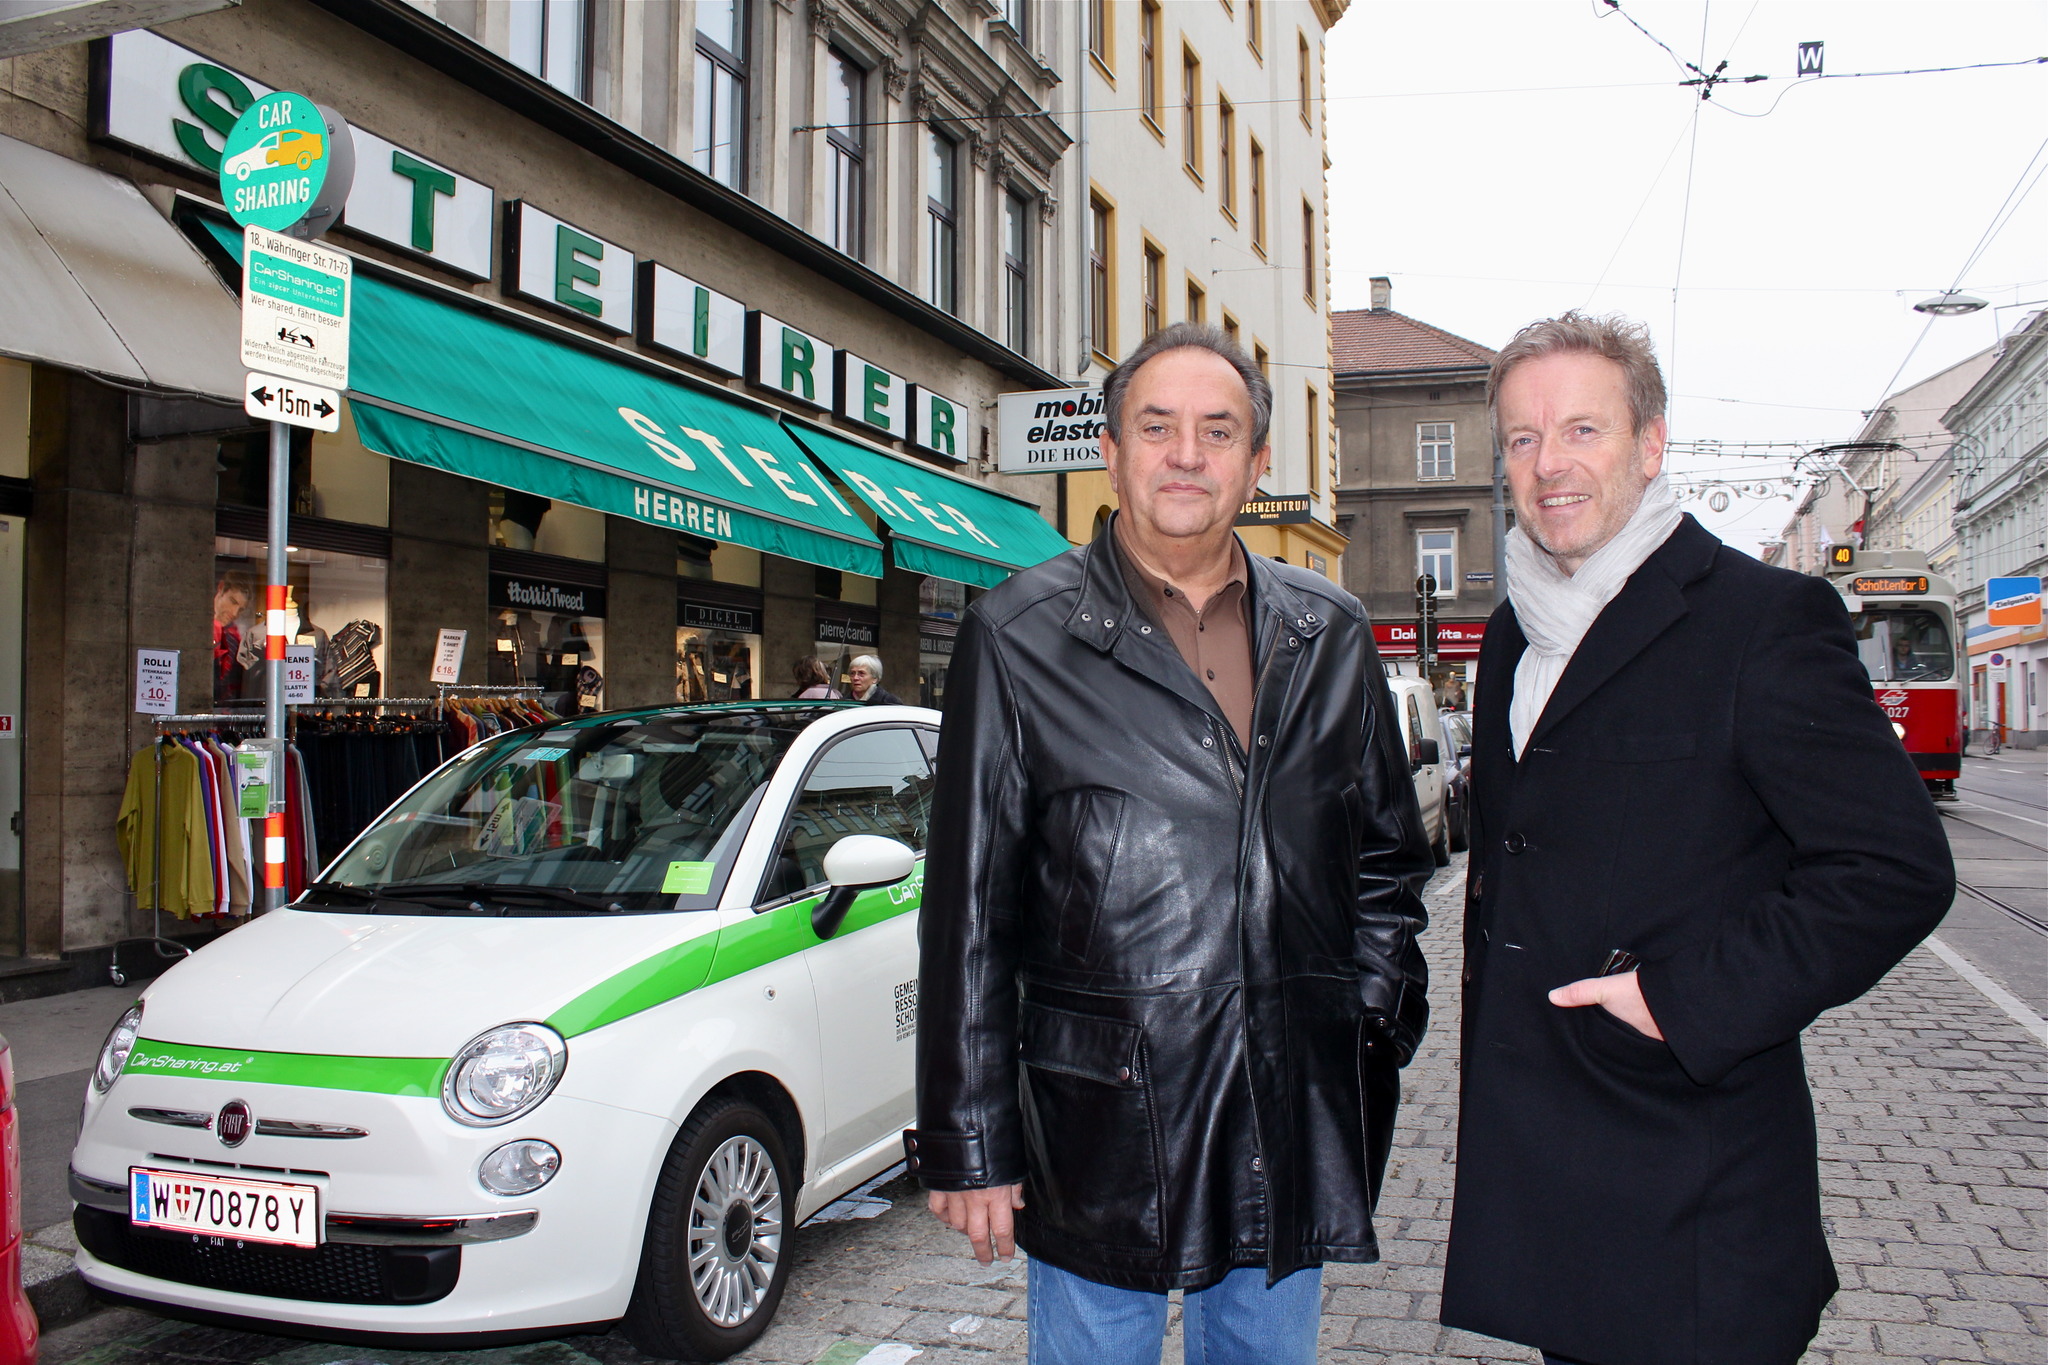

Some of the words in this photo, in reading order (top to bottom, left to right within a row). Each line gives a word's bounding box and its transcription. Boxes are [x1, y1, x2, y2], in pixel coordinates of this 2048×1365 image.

[1800, 46, 1823, 70] W
[258, 100, 292, 130] CAR
[234, 177, 310, 213] SHARING
[173, 62, 956, 456] STEIRER
[266, 237, 311, 262] Währinger
[313, 253, 327, 269] Str.
[328, 258, 349, 275] 71-73
[254, 277, 266, 286] Ein
[268, 281, 290, 293] zipcar
[292, 289, 338, 308] Unternehmen
[250, 294, 265, 306] Wer
[268, 299, 296, 316] shared,
[297, 307, 316, 322] fährt
[318, 314, 341, 329] besser
[244, 338, 286, 356] Widerrechtlich
[287, 349, 318, 365] abgestellte
[318, 357, 346, 372] Fahrzeuge
[244, 349, 267, 360] werden
[267, 354, 309, 372] kostenpflichtig
[310, 366, 345, 380] abgeschleppt
[276, 386, 310, 418] 15m
[1034, 392, 1106, 419] mobi
[1027, 448, 1058, 463] DIE
[1063, 446, 1103, 461] HOS
[618, 407, 1000, 548] STEIRER
[634, 486, 733, 538] HERREN
[1836, 548, 1850, 562] 40
[1856, 578, 1917, 592] Schottentor
[1995, 595, 2033, 609] Zielpunkt
[699, 608, 740, 624] DIGEL
[819, 620, 845, 639] pierre
[847, 626, 872, 643] cardin
[143, 658, 171, 667] ROLLI
[1884, 706, 1909, 718] 027
[222, 1113, 245, 1135] FIAT
[139, 1203, 147, 1215] A
[153, 1182, 170, 1219] W
[210, 1236, 225, 1247] FIAT
